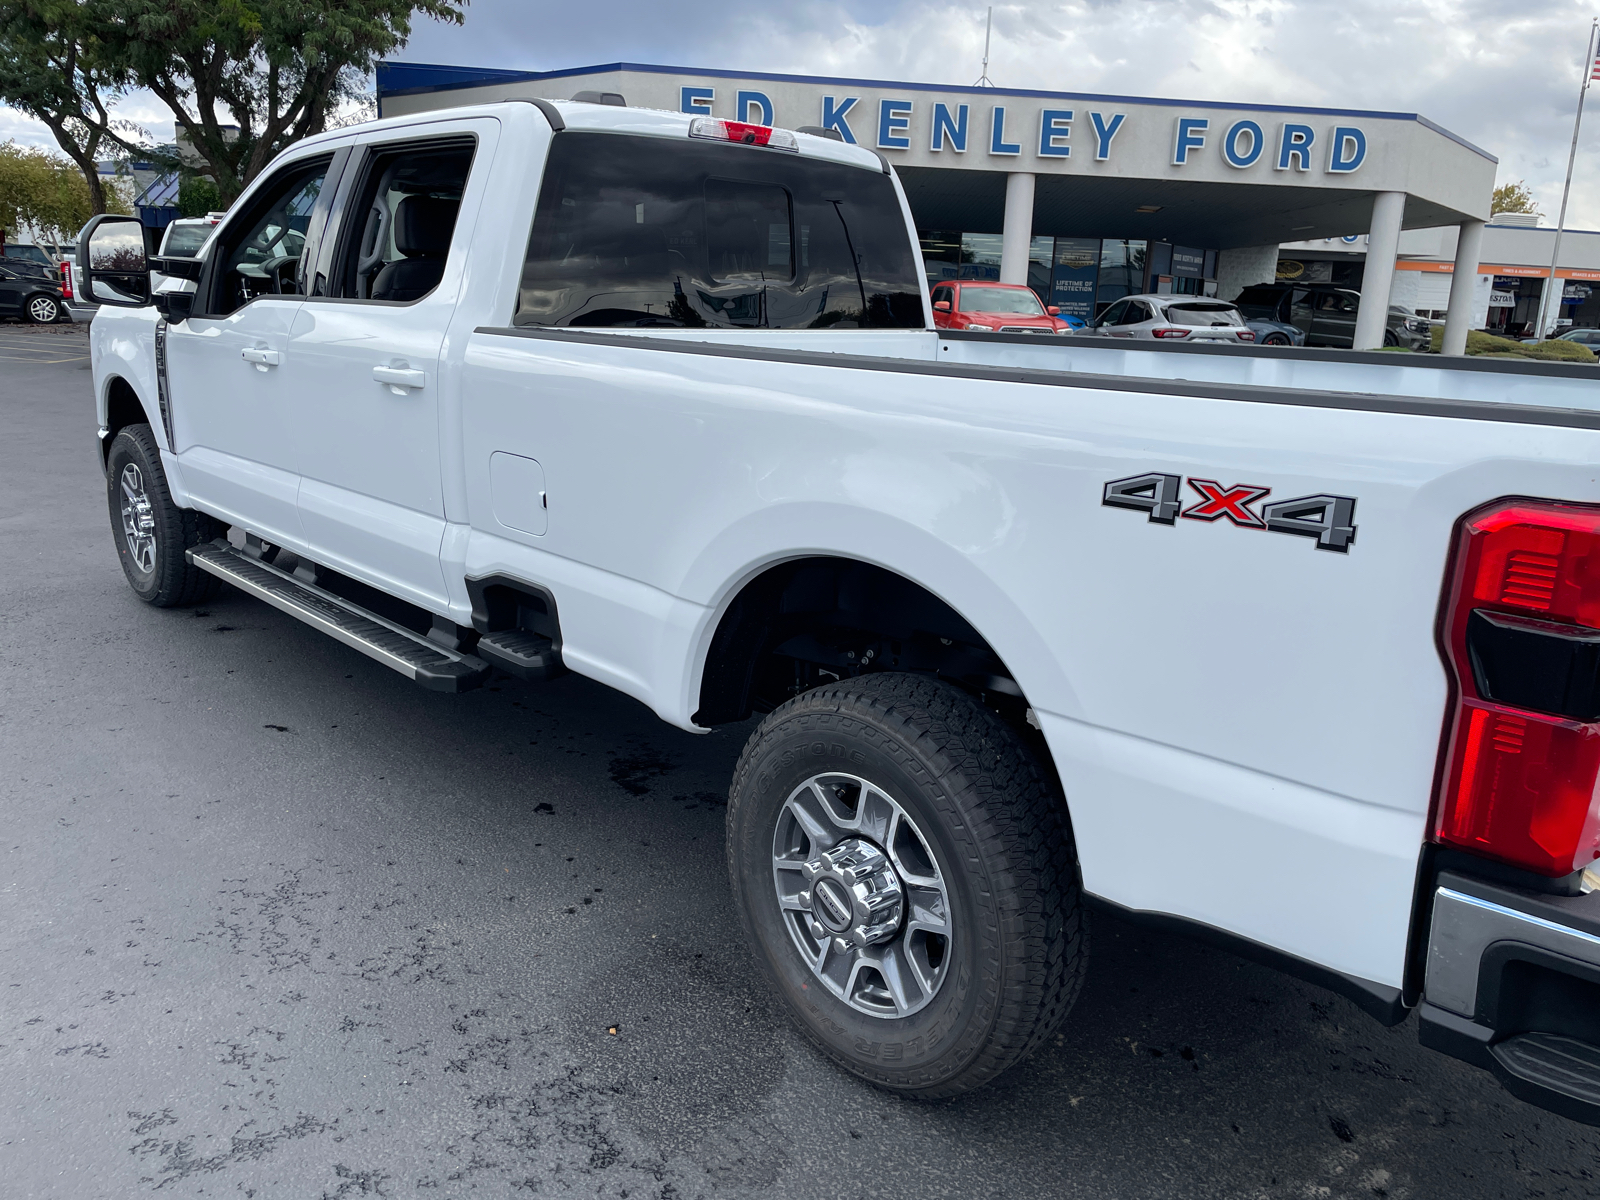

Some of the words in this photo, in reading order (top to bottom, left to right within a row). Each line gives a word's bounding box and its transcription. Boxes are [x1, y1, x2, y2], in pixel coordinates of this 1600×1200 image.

[679, 86, 775, 127] ED
[822, 94, 1126, 162] KENLEY
[1171, 115, 1368, 174] FORD
